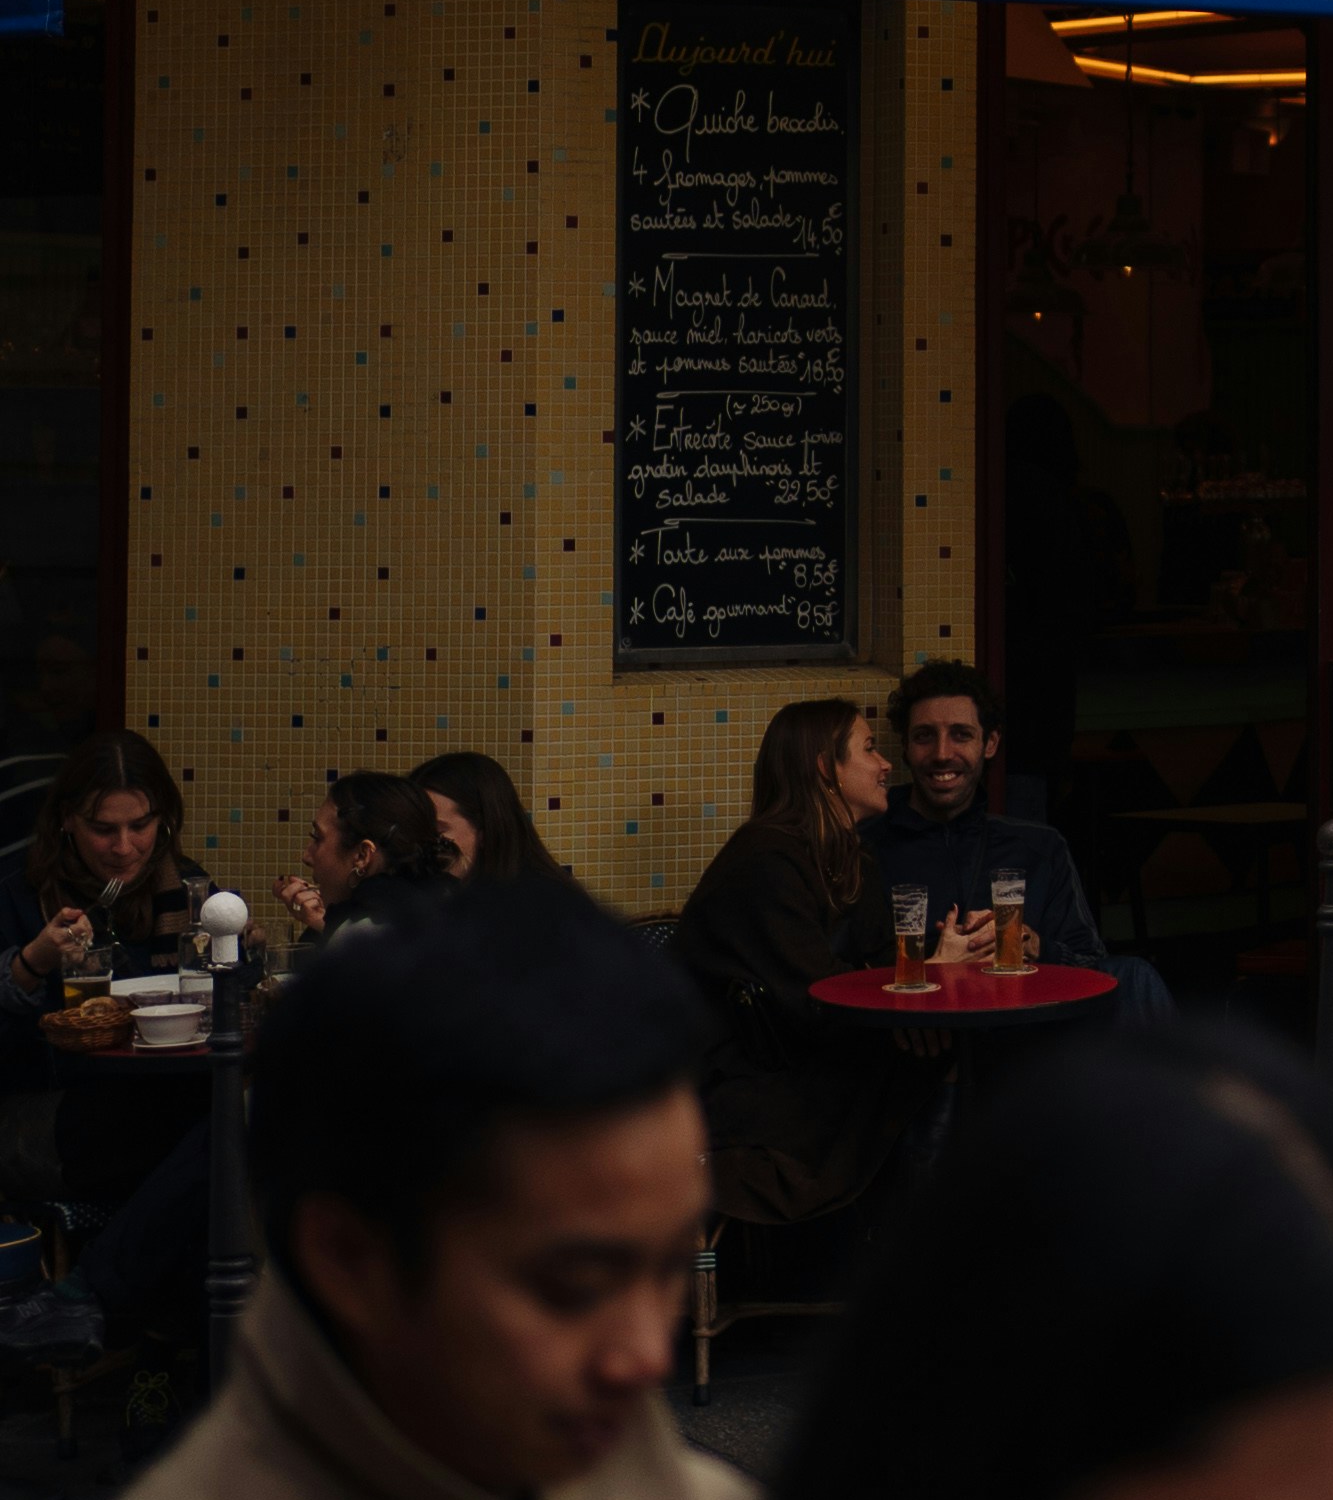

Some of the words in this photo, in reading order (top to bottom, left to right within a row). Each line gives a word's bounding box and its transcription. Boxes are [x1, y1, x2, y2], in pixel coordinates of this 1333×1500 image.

[654, 83, 759, 163] Quiche
[632, 146, 648, 185] 4
[763, 165, 838, 198] pommes
[703, 200, 724, 228] et
[733, 197, 797, 230] salade
[654, 261, 731, 323] Magret
[737, 276, 761, 307] de
[630, 326, 678, 345] sauce
[733, 313, 802, 345] haricots
[806, 316, 843, 344] verts
[629, 346, 647, 376] et
[656, 355, 731, 385] pommes
[628, 456, 688, 499] gratin
[695, 449, 792, 487] dauphinois
[799, 449, 823, 476] et
[641, 524, 708, 565] Tarte
[715, 545, 754, 562] aux
[759, 542, 827, 575] pommes
[653, 583, 696, 639] Café
[703, 597, 790, 638] gourmand
